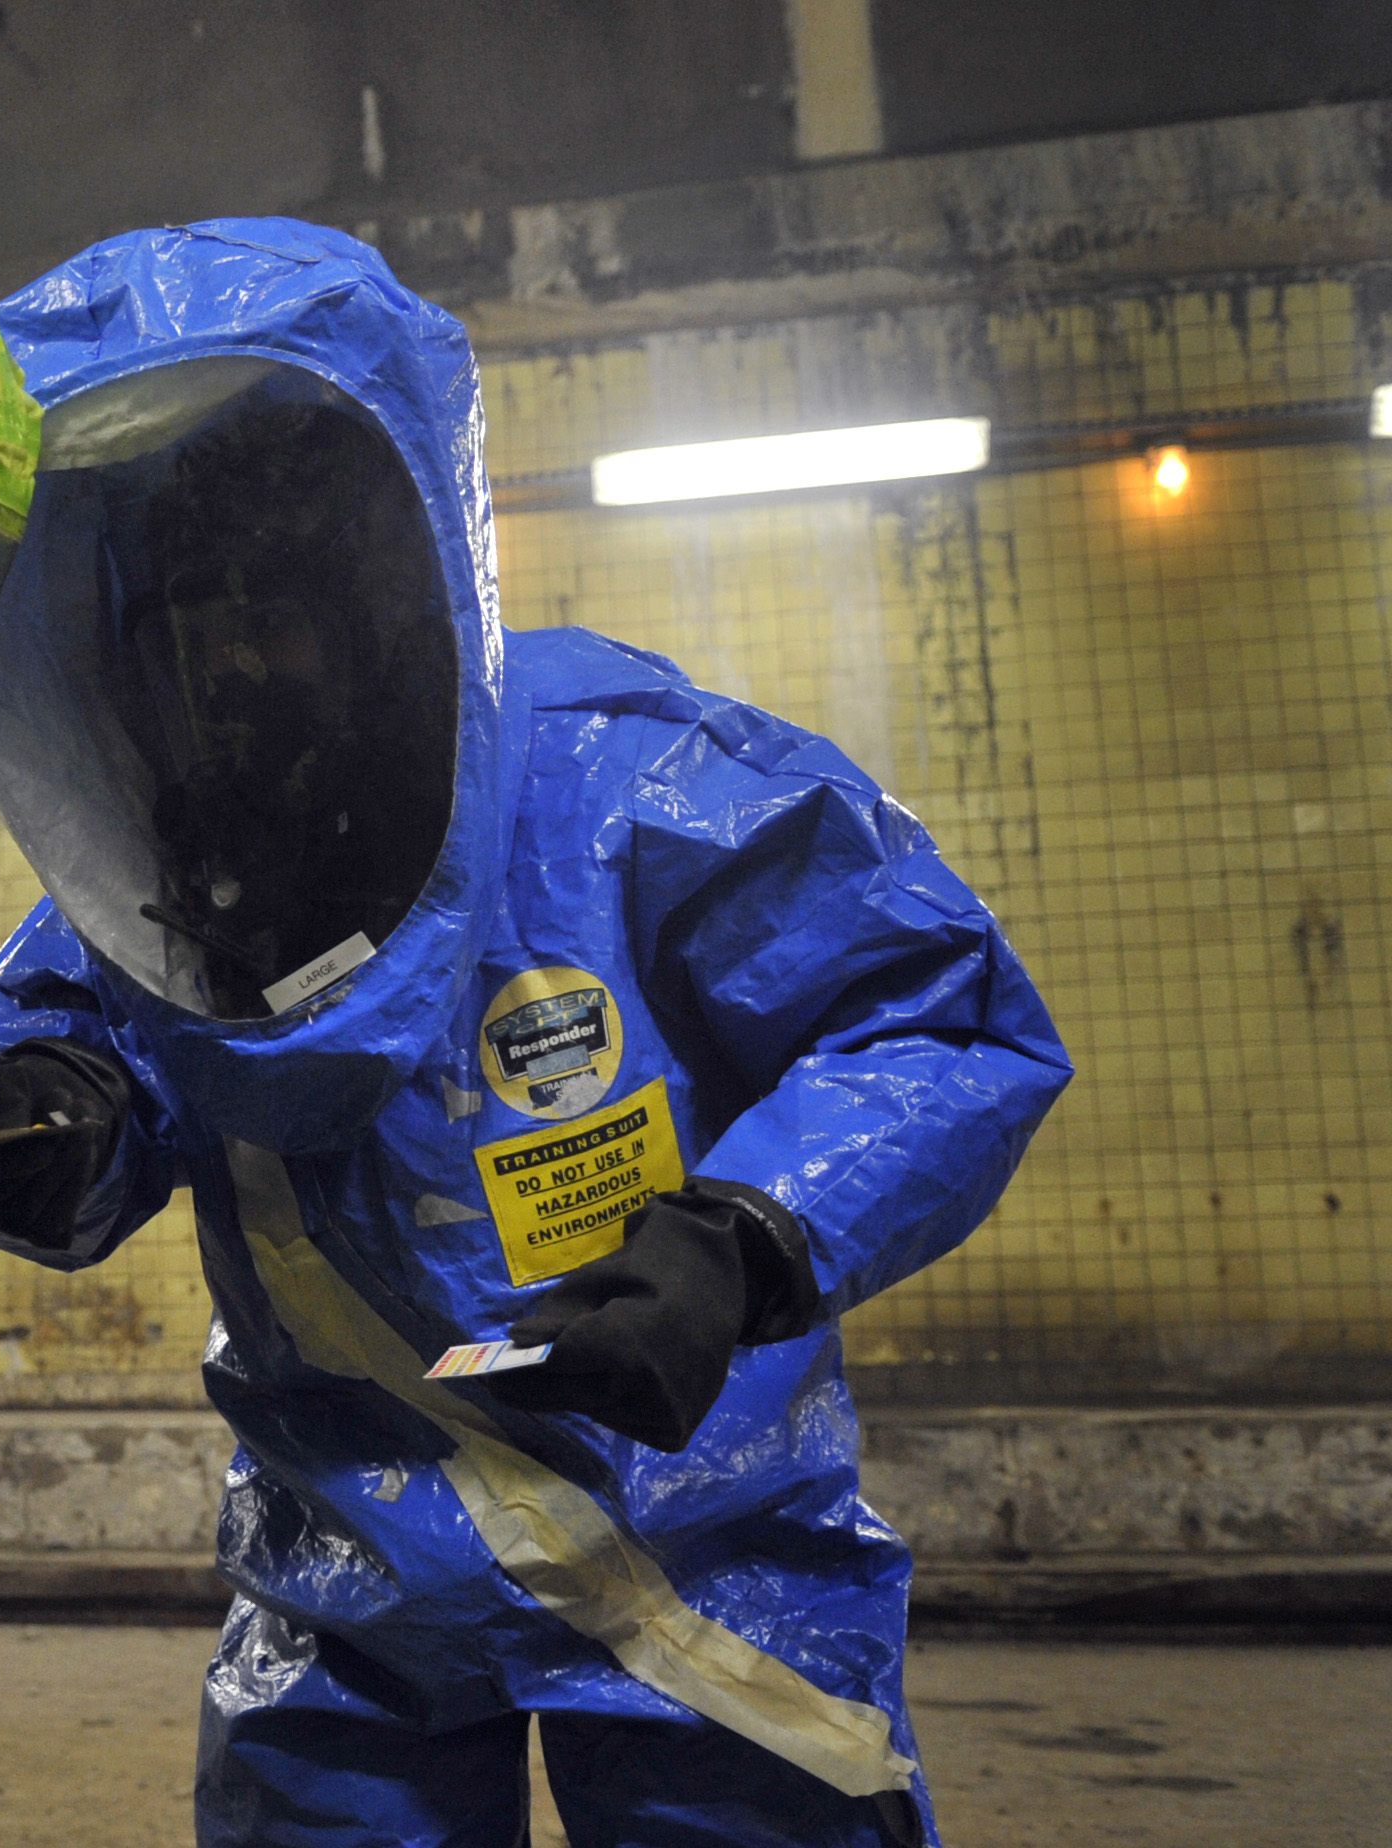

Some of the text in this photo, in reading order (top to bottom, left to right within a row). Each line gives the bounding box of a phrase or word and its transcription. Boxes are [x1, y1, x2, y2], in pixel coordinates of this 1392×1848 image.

[298, 959, 338, 989] LARGE
[492, 992, 599, 1036] SYSTEM
[508, 1023, 597, 1059] Responder
[499, 1113, 643, 1170] TRAINING SUIT
[515, 1137, 645, 1195] DO NOT USE IN
[535, 1166, 642, 1216] HAZARDOUS
